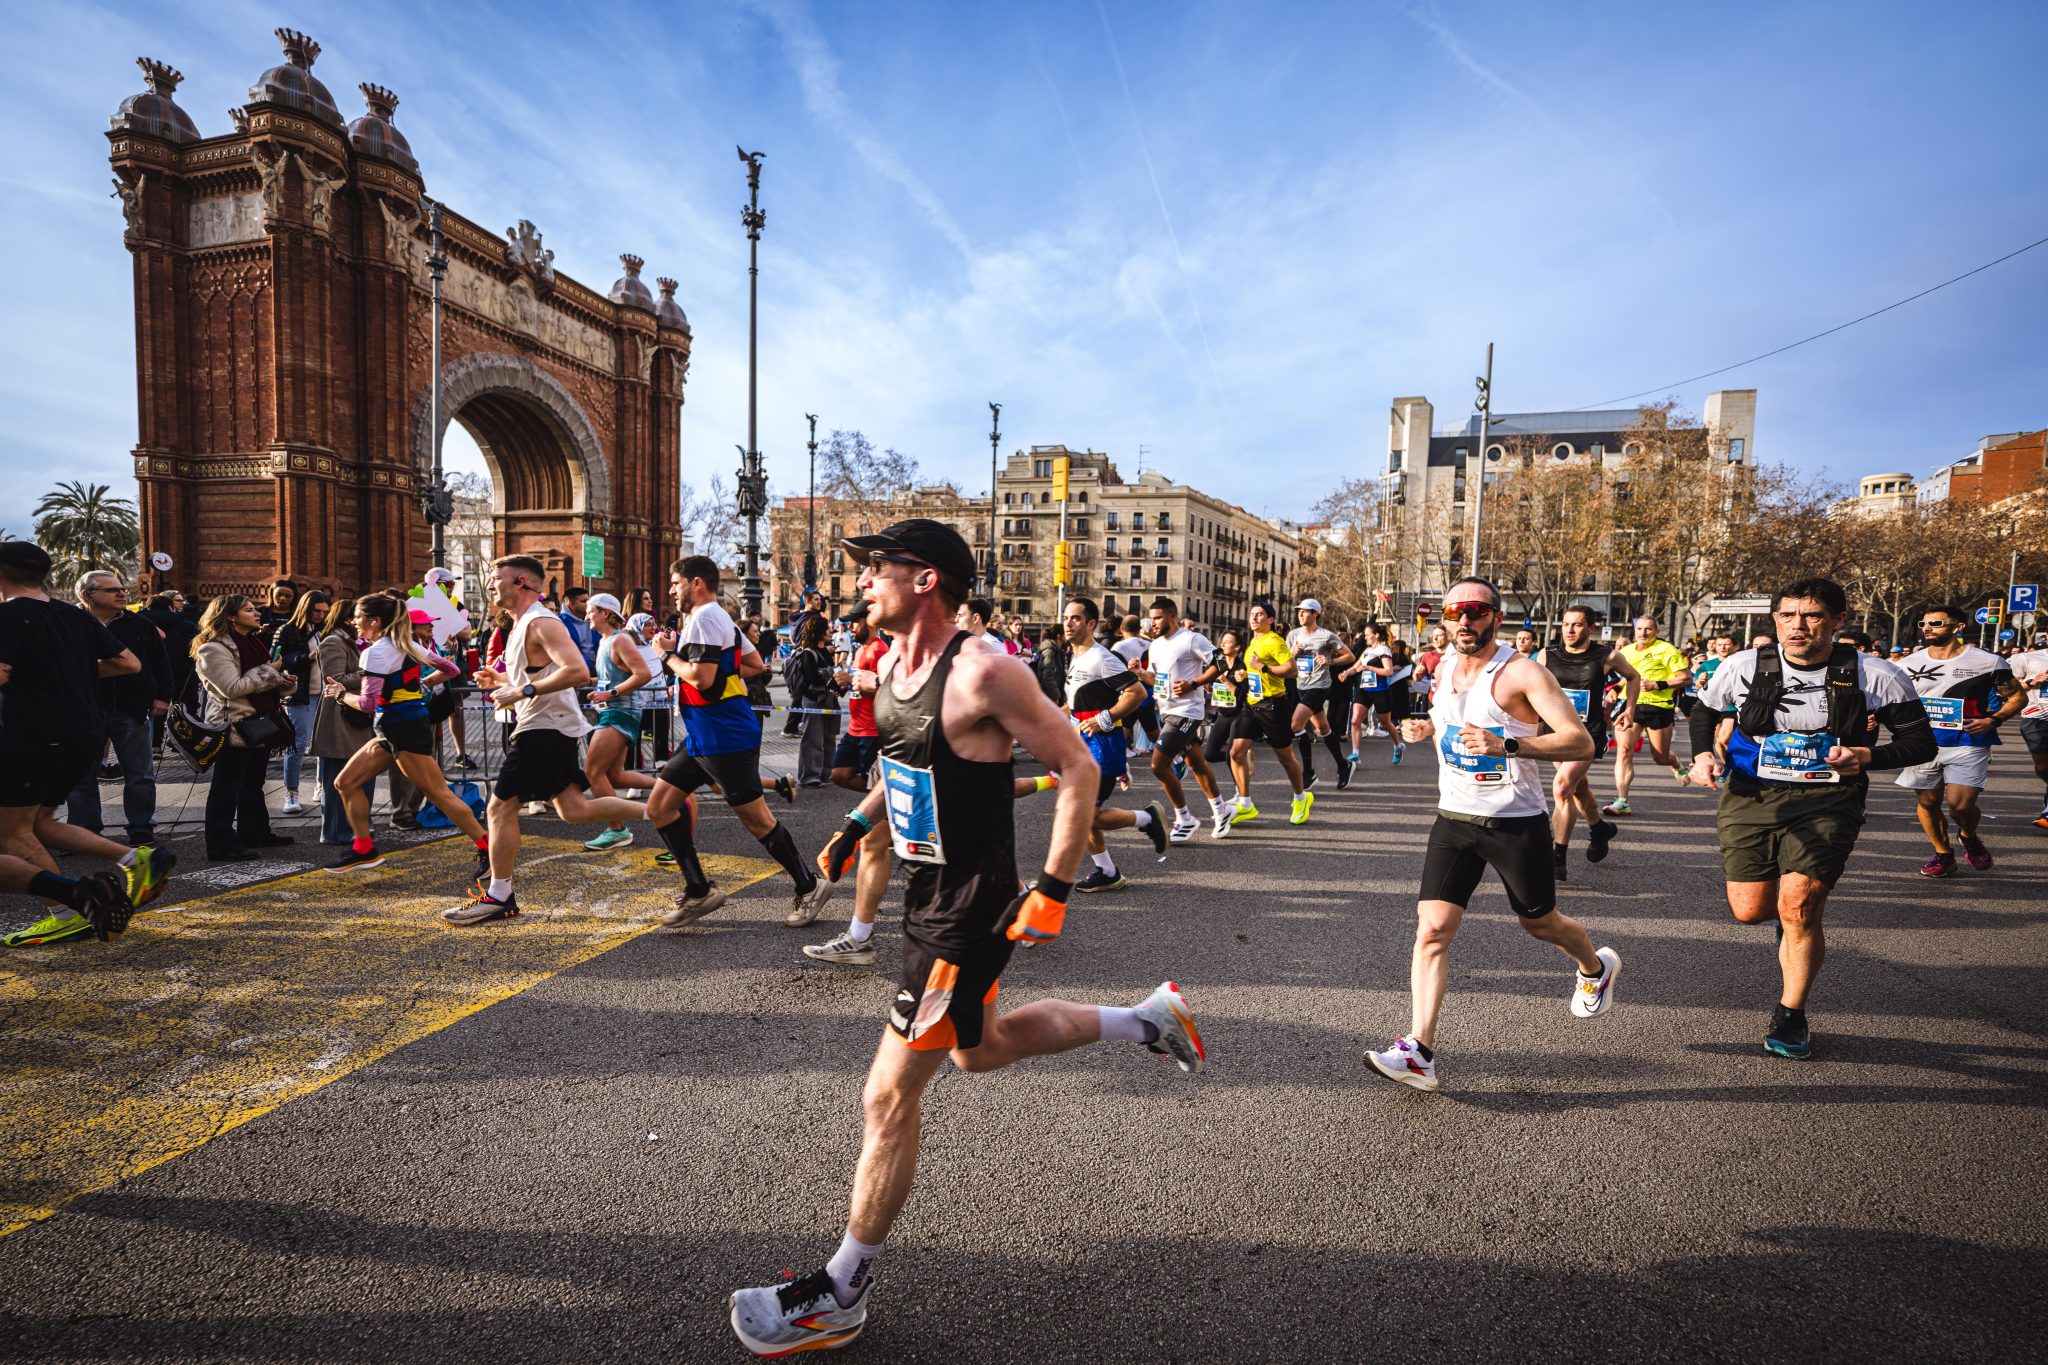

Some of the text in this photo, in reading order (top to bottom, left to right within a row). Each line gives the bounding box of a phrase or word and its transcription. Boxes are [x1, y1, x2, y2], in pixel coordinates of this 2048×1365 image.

[2014, 587, 2033, 602] P
[1784, 747, 1818, 760] JUAN
[1790, 757, 1810, 766] 5277
